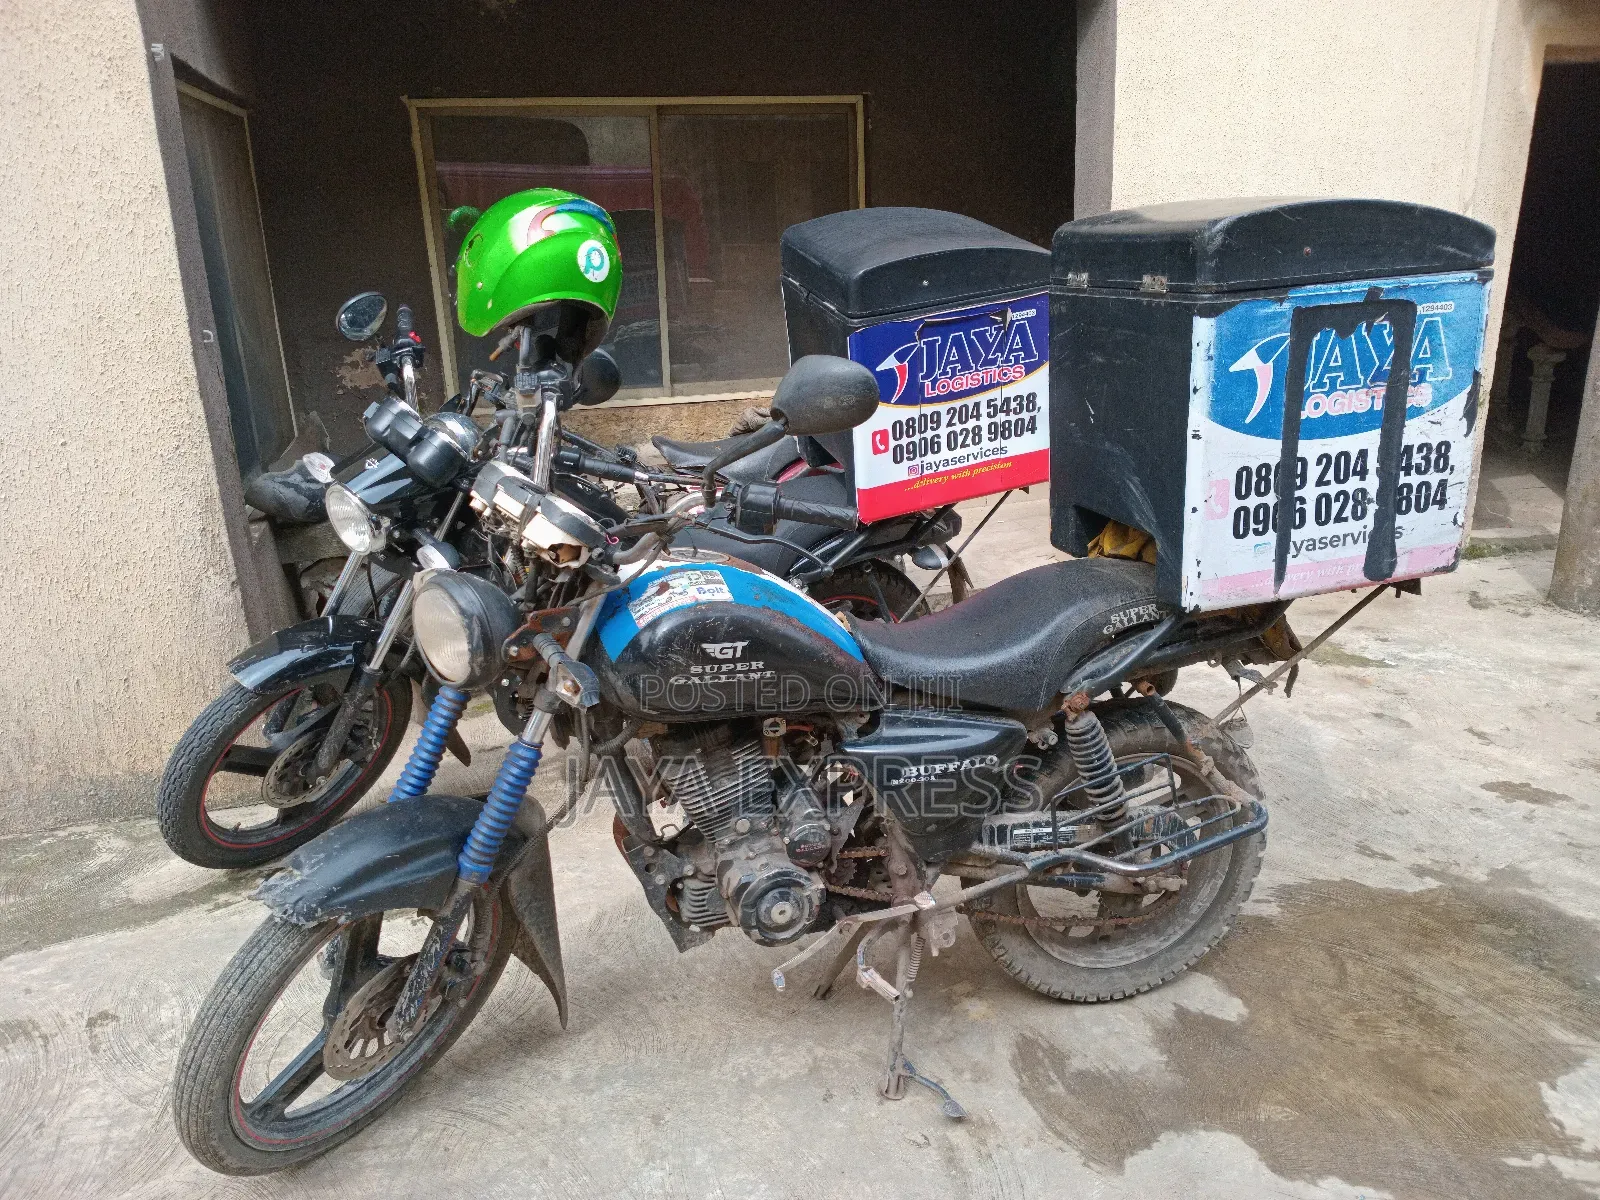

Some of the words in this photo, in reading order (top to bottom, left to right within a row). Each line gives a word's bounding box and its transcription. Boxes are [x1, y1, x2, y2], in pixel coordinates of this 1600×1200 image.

[1421, 303, 1453, 313] 1294403
[920, 321, 1038, 382] JAYA
[1304, 317, 1452, 392] AYA
[925, 365, 1025, 397] LOGISTICS
[892, 410, 941, 441] 0809
[946, 400, 982, 428] 204
[987, 391, 1042, 419] 5438,
[893, 433, 941, 465] 0906
[946, 424, 982, 451] 028
[987, 415, 1038, 442] 9804
[920, 445, 1009, 475] jayaservices
[951, 468, 971, 480] with
[972, 461, 1012, 477] precision
[1315, 447, 1369, 487] 204
[1376, 440, 1455, 478] 438,
[1315, 487, 1368, 526] 028
[1376, 478, 1449, 516] 804
[696, 586, 725, 596] Bolt
[1111, 603, 1158, 624] SUPER
[703, 640, 751, 659] GT
[669, 670, 776, 685] GALLANT
[690, 660, 765, 674] SUPER
[902, 754, 998, 778] BUFFALO
